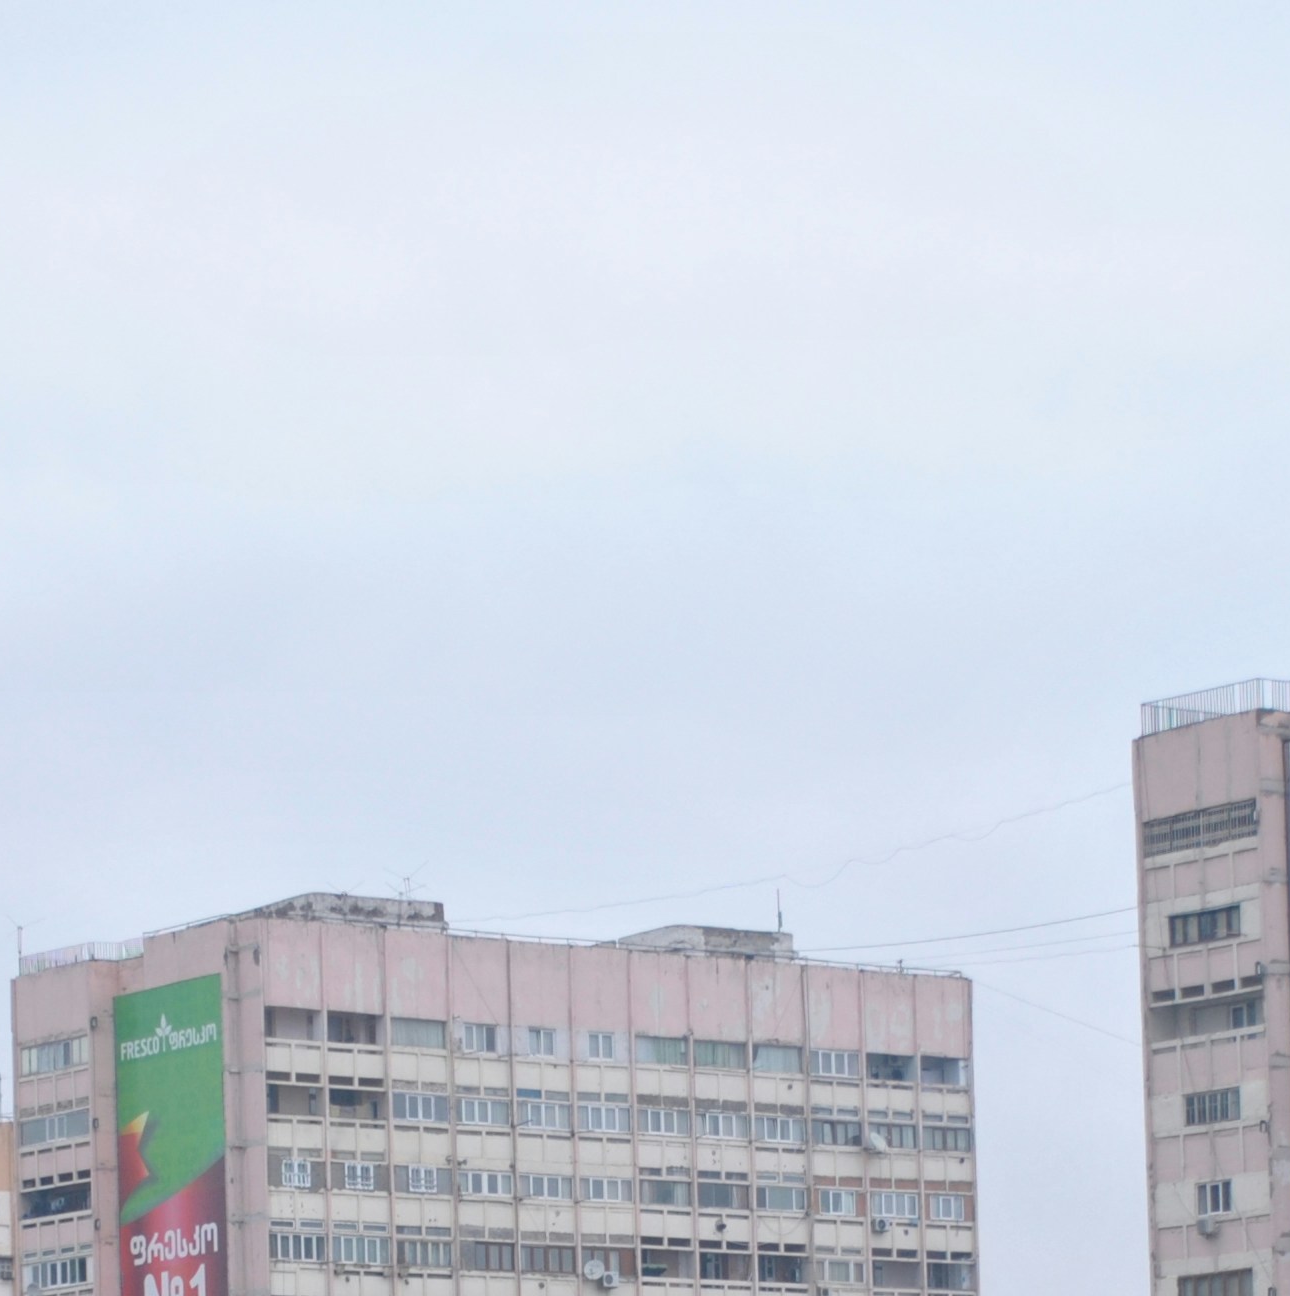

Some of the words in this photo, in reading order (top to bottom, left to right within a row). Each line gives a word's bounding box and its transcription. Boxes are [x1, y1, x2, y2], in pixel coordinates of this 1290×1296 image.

[120, 1035, 160, 1061] FRESCO
[168, 1022, 217, 1051] ფრესკო
[130, 1222, 219, 1267] ფრესკო
